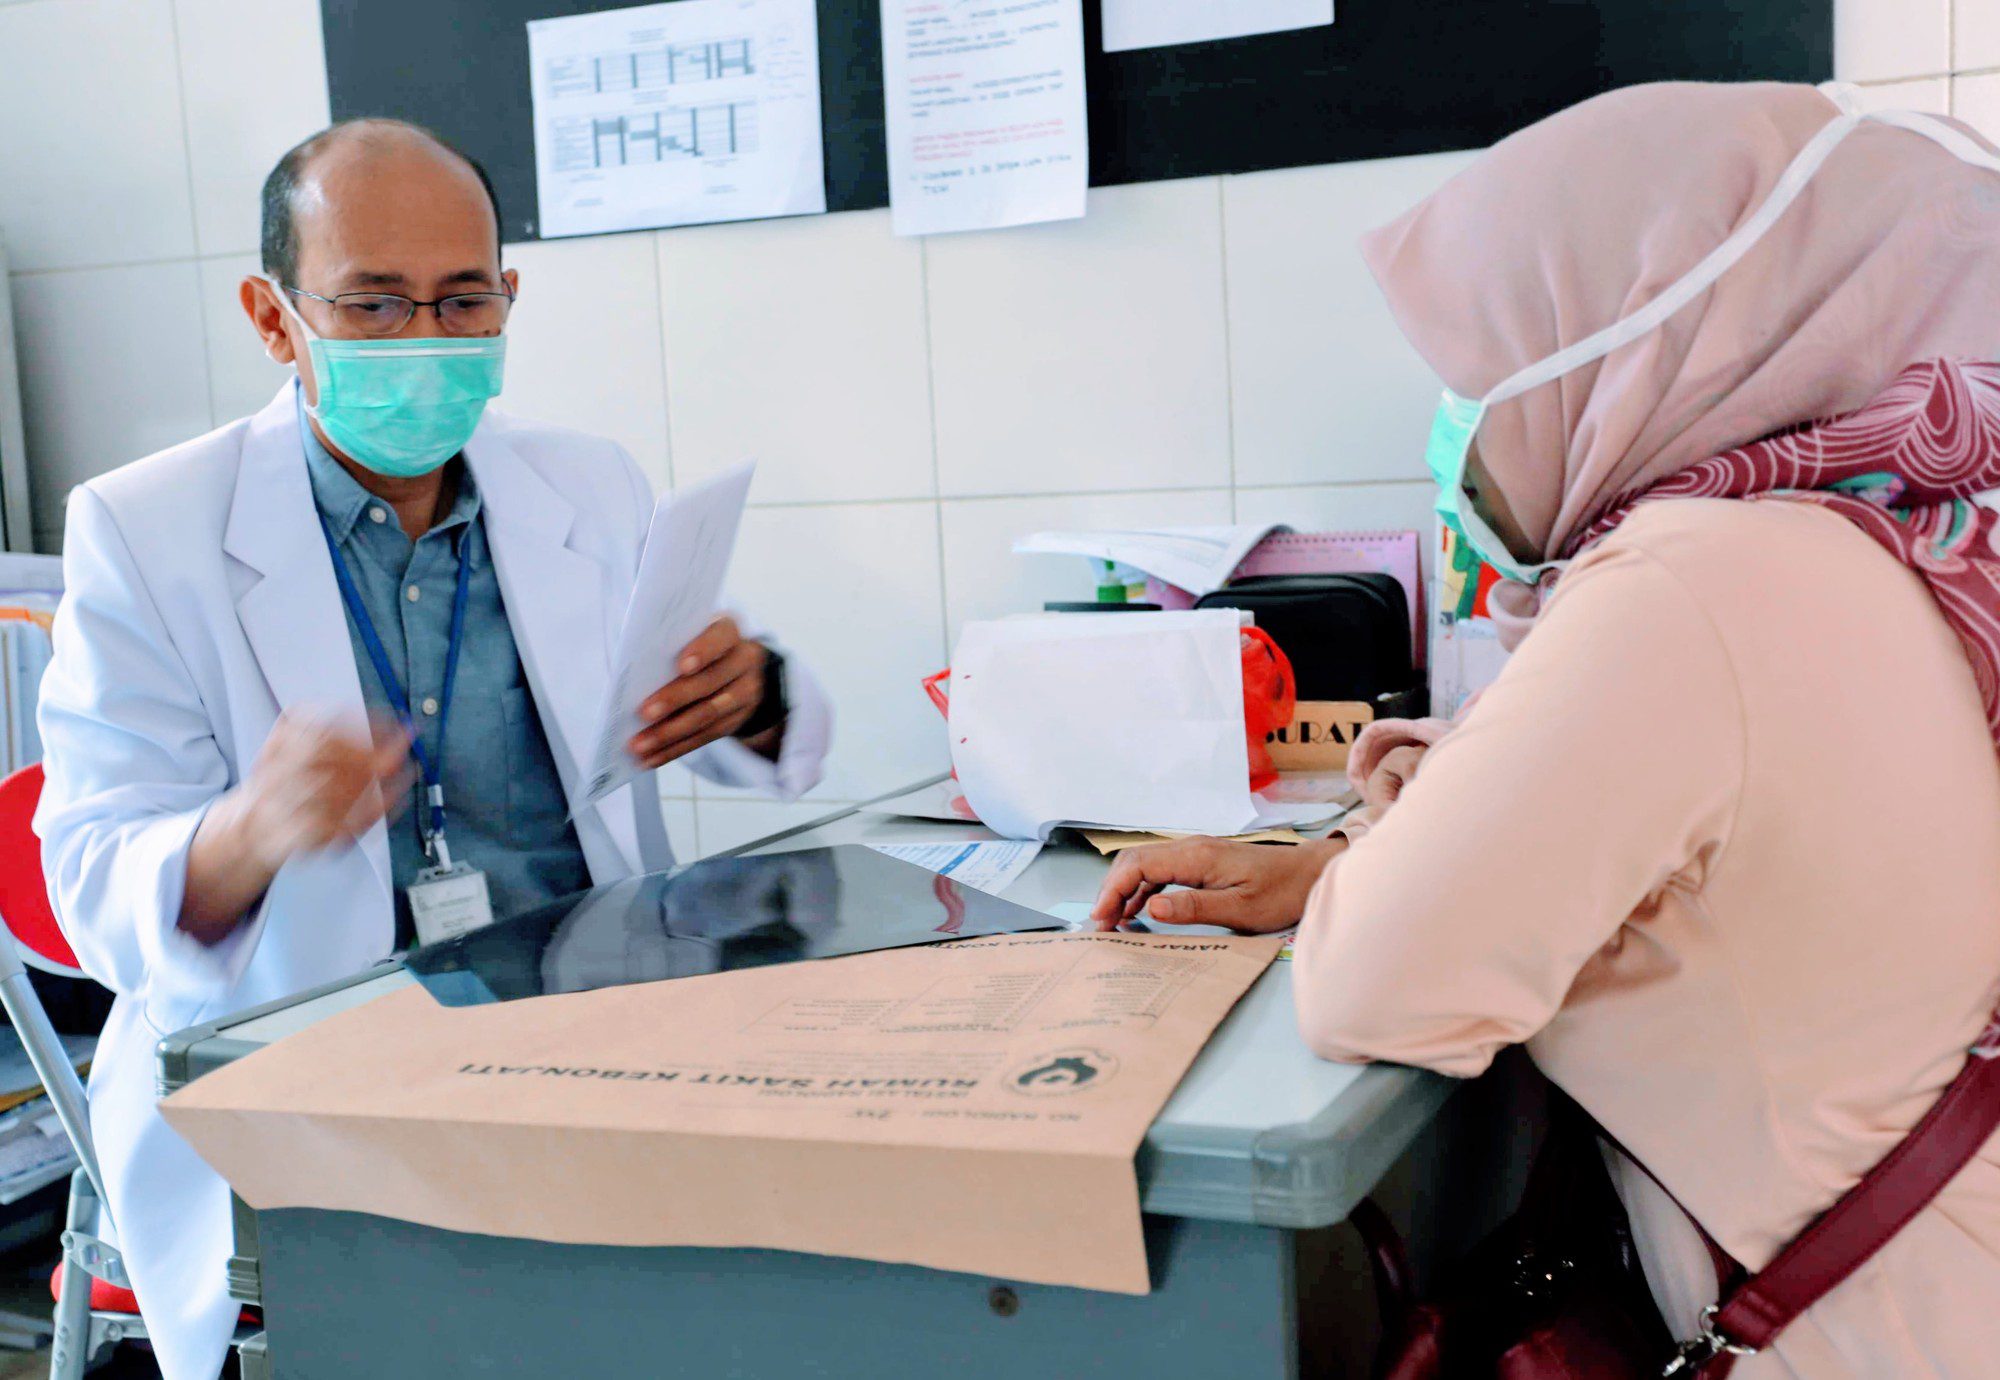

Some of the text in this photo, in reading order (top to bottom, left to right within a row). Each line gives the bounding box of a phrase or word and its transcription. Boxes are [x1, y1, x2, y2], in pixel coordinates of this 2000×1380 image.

[1265, 721, 1369, 744] URAT
[1062, 936, 1148, 947] DIBAWA
[1153, 944, 1228, 952] HARAP
[459, 1064, 979, 1089] RUMAH SAKIT KEBONJATI
